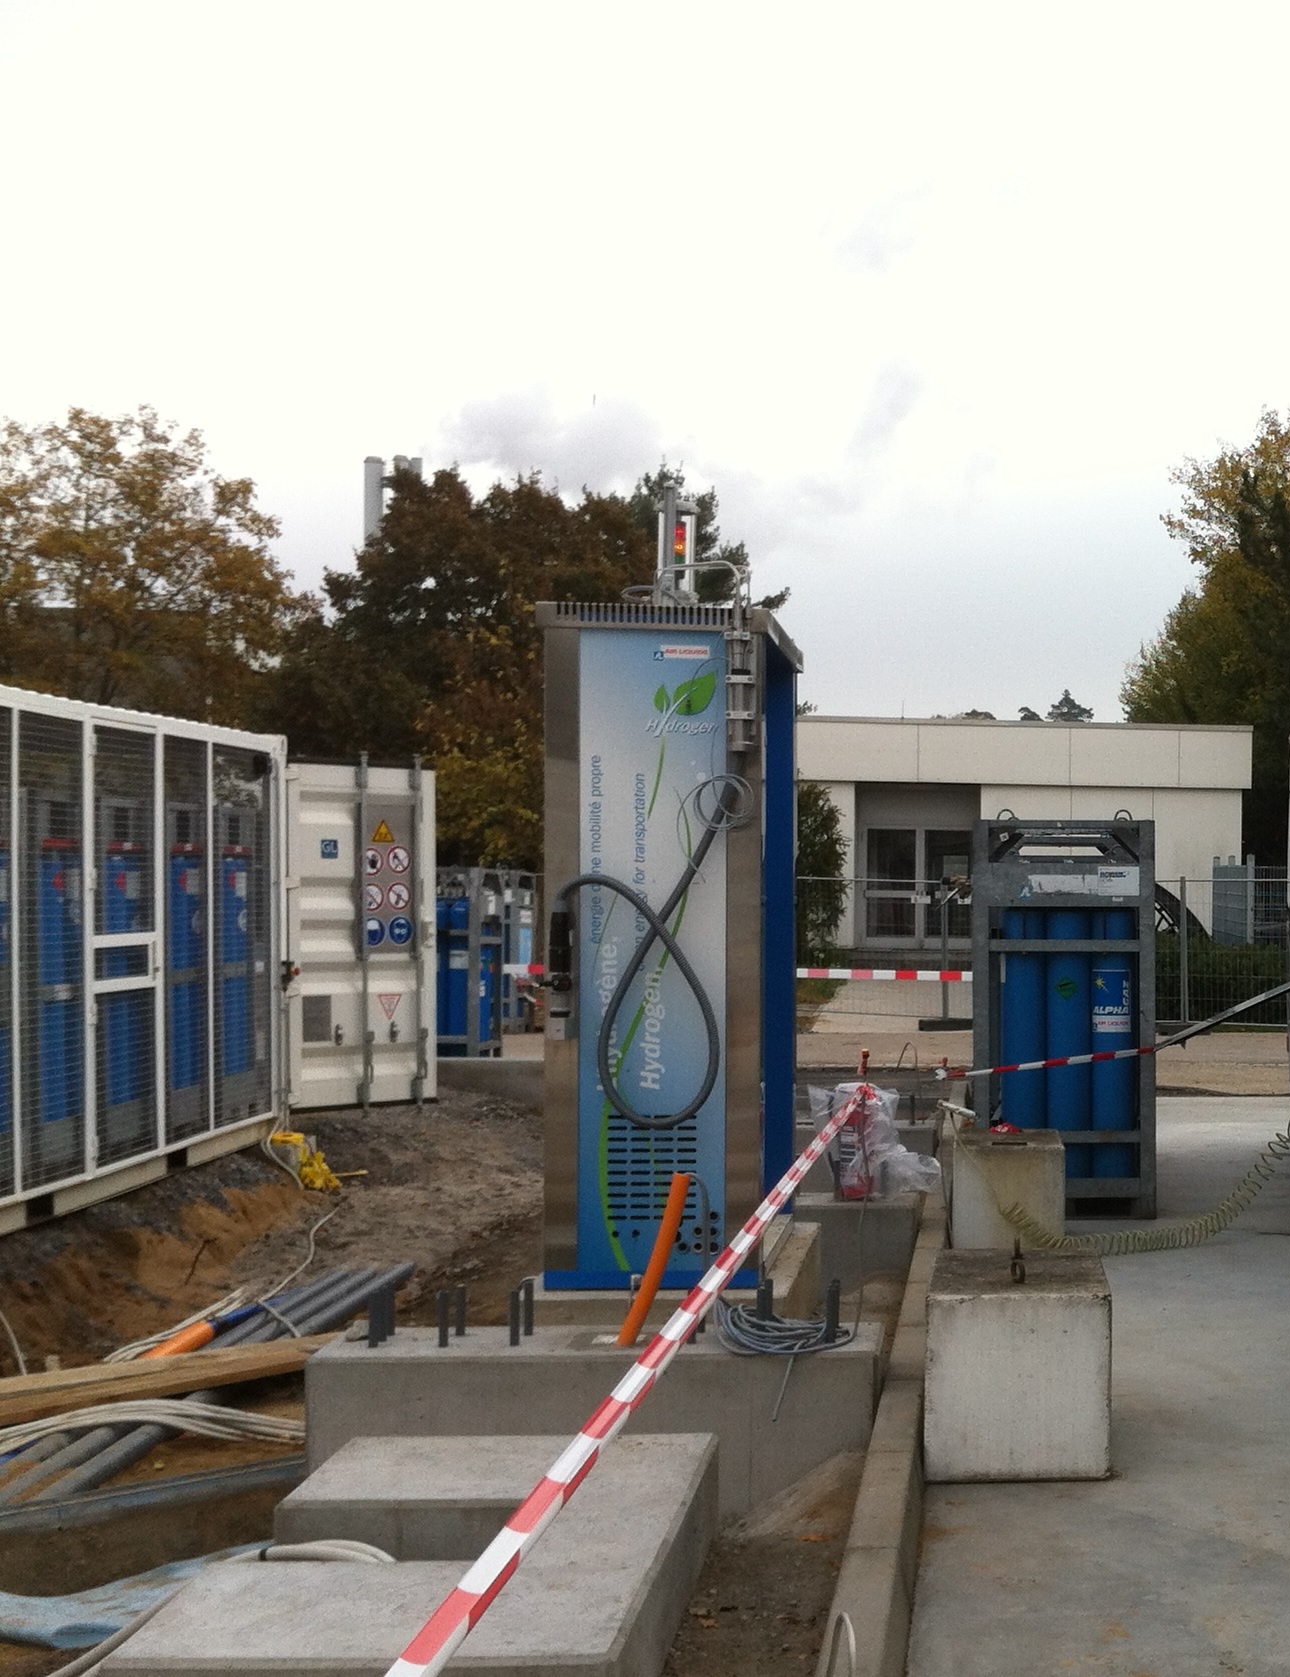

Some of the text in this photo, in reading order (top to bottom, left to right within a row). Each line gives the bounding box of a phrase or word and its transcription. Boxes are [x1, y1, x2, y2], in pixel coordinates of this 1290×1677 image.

[645, 718, 719, 739] Hydrogen
[590, 755, 604, 797] propre
[588, 801, 602, 853] mobilité
[634, 773, 647, 864] transportation
[632, 867, 646, 885] for
[1093, 1005, 1130, 1014] ALPHA
